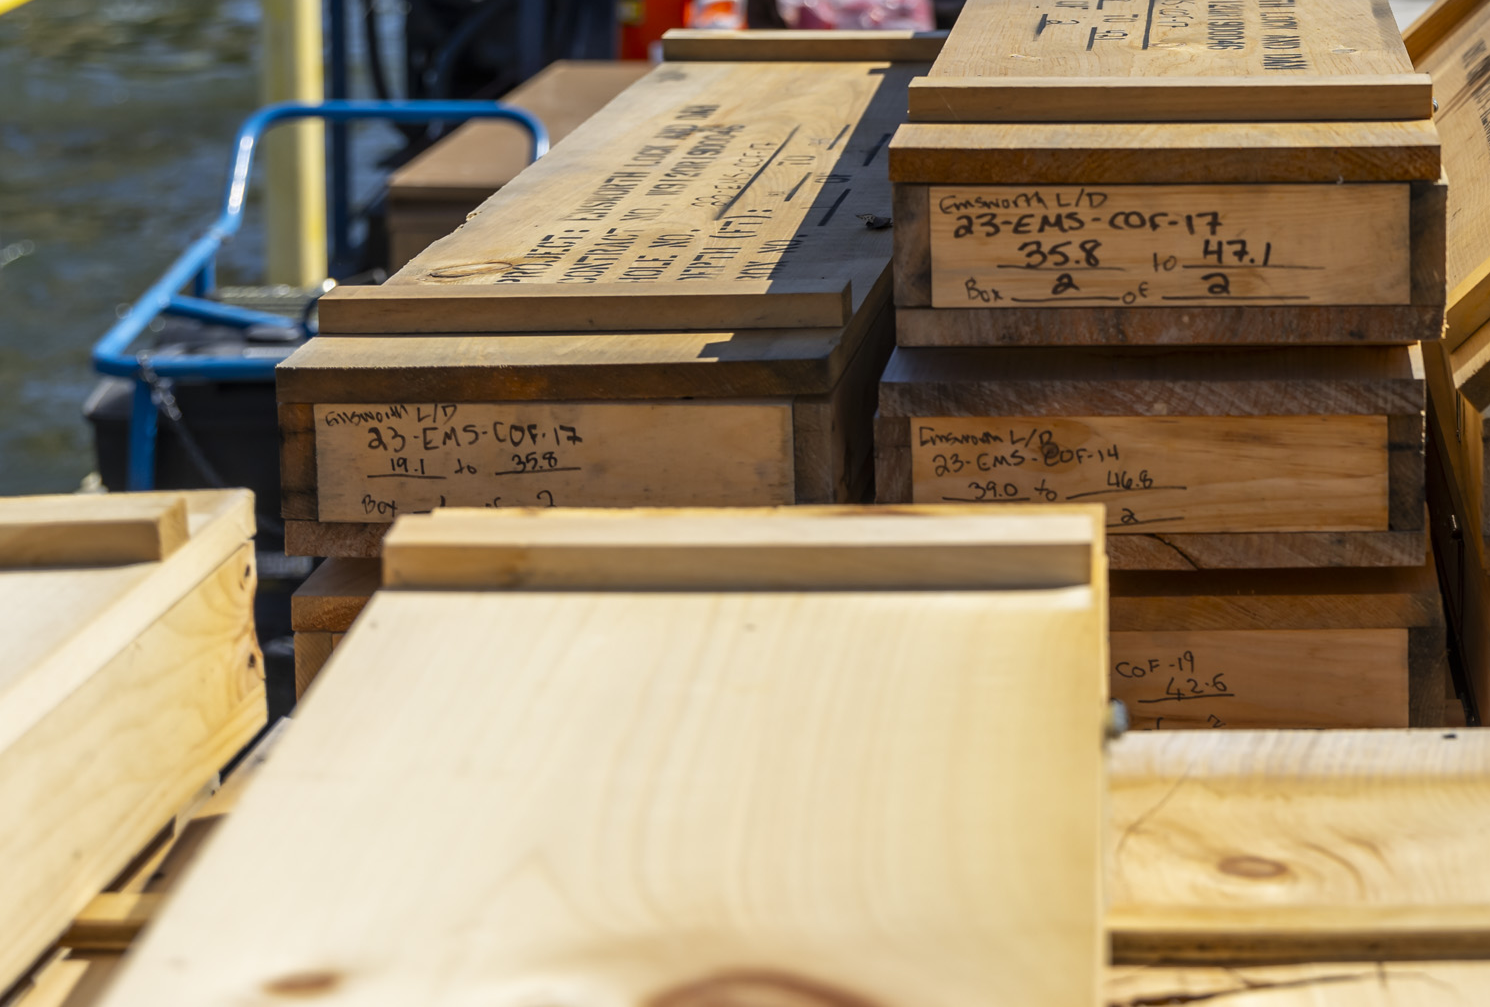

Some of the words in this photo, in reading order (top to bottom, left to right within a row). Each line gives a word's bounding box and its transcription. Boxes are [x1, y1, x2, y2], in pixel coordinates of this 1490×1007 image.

[1056, 188, 1108, 209] L/D
[953, 211, 1223, 239] 23-EMS-COF-17
[493, 228, 590, 285] PROJECT:
[556, 228, 645, 284] CONTRACT
[618, 203, 671, 221] NO.
[615, 255, 678, 284] HOLE
[648, 229, 701, 248] NO.
[757, 234, 808, 254] NO.
[1017, 239, 1102, 269] 35.8
[1153, 252, 1177, 272] to
[1202, 239, 1271, 266] 47.1
[965, 277, 1003, 303] Box
[1052, 273, 1080, 295] 2
[1201, 272, 1231, 295] 2
[390, 457, 425, 475] 19.1
[454, 458, 477, 475] to
[512, 451, 558, 474] 35.8
[968, 480, 1018, 500] 39.0
[1034, 479, 1057, 501] to
[1120, 508, 1140, 524] 2
[1165, 673, 1227, 701] 42.6
